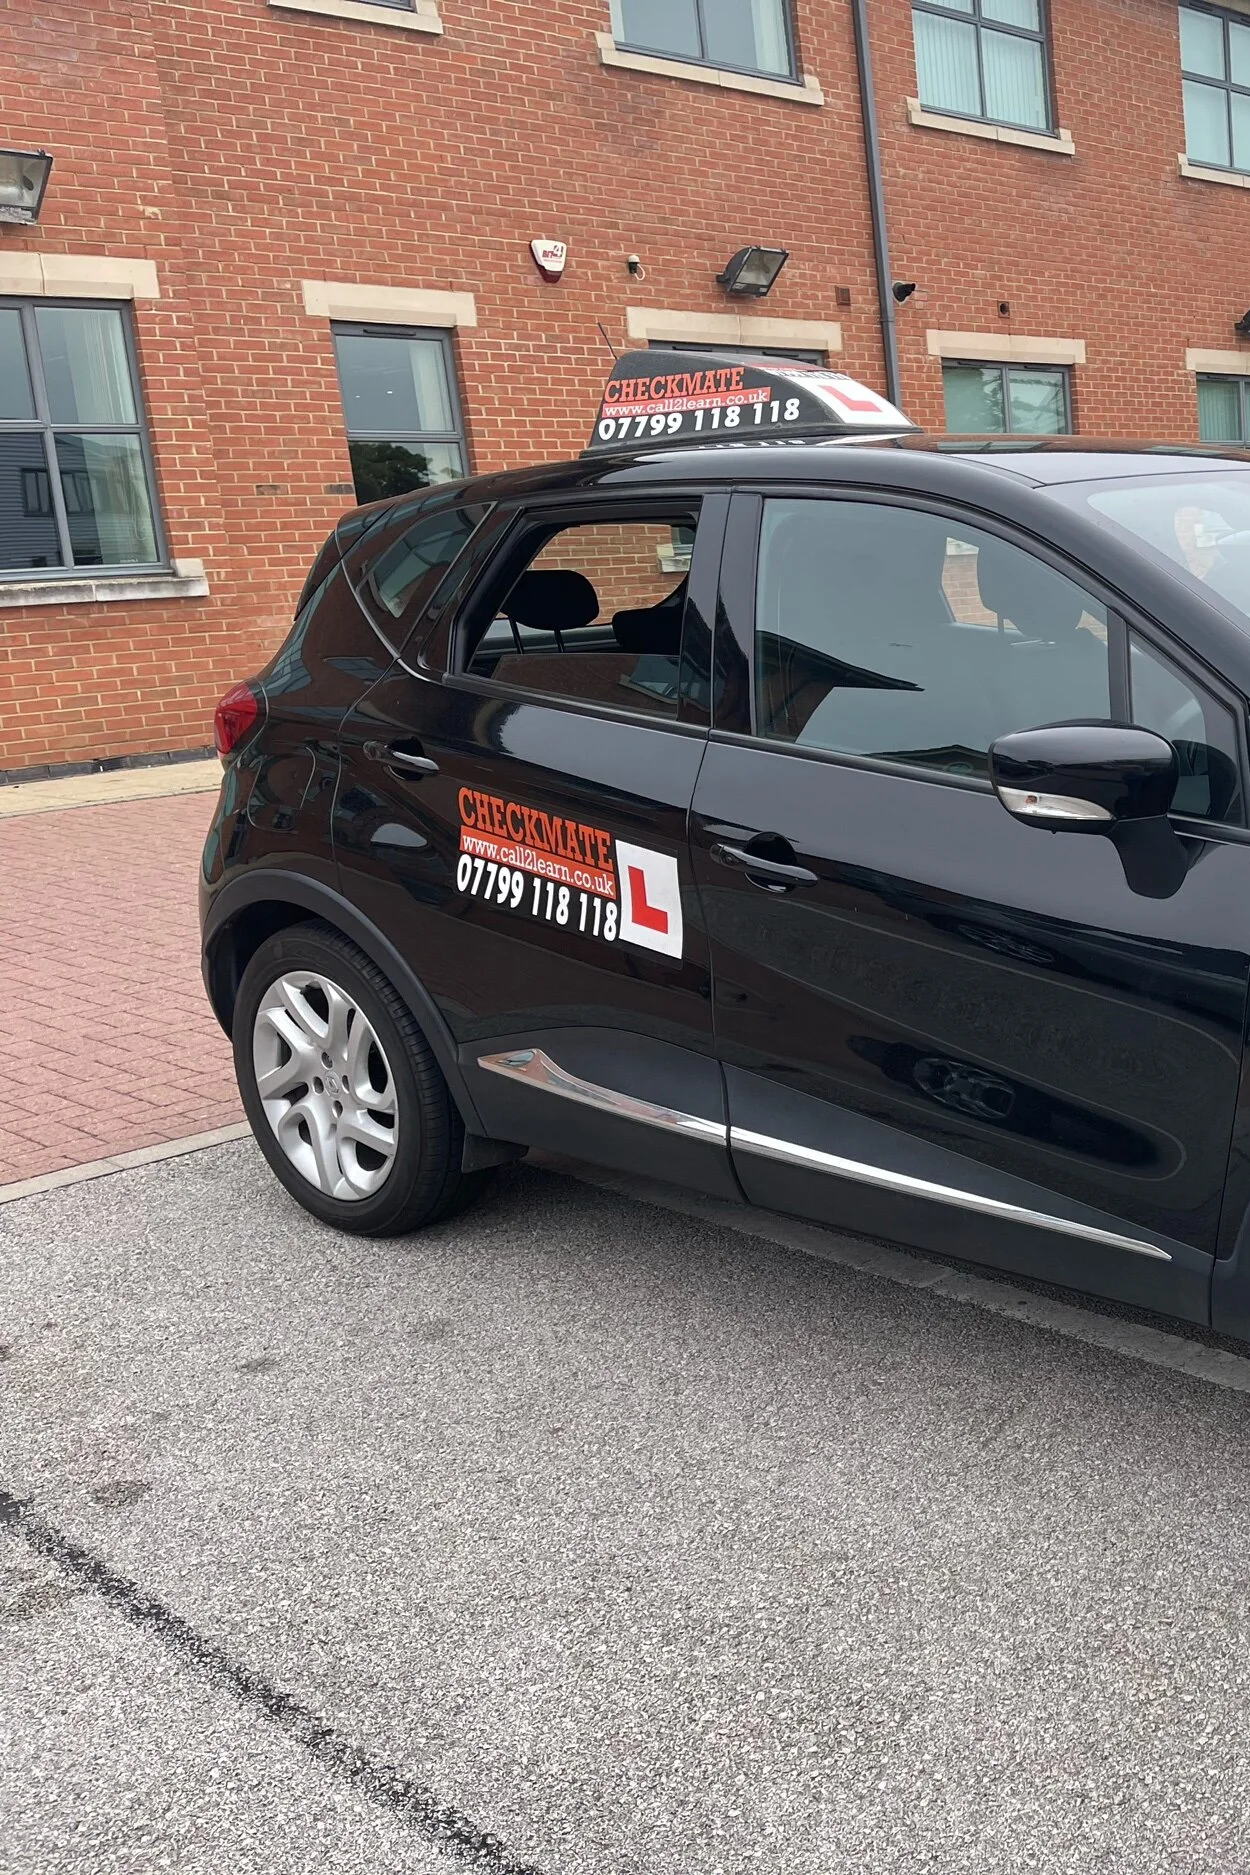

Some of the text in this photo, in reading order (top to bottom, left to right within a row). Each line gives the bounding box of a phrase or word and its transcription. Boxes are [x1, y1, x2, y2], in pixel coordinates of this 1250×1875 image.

[604, 367, 745, 403] CHECKMATE
[604, 390, 768, 418] www.call2learn.co.uk
[599, 398, 800, 441] 07799 118 118
[458, 787, 614, 872] CHECKMATE
[462, 834, 614, 896] www.call2learn.co.uk
[456, 854, 618, 942] 07799 118 118
[628, 865, 668, 935] L
